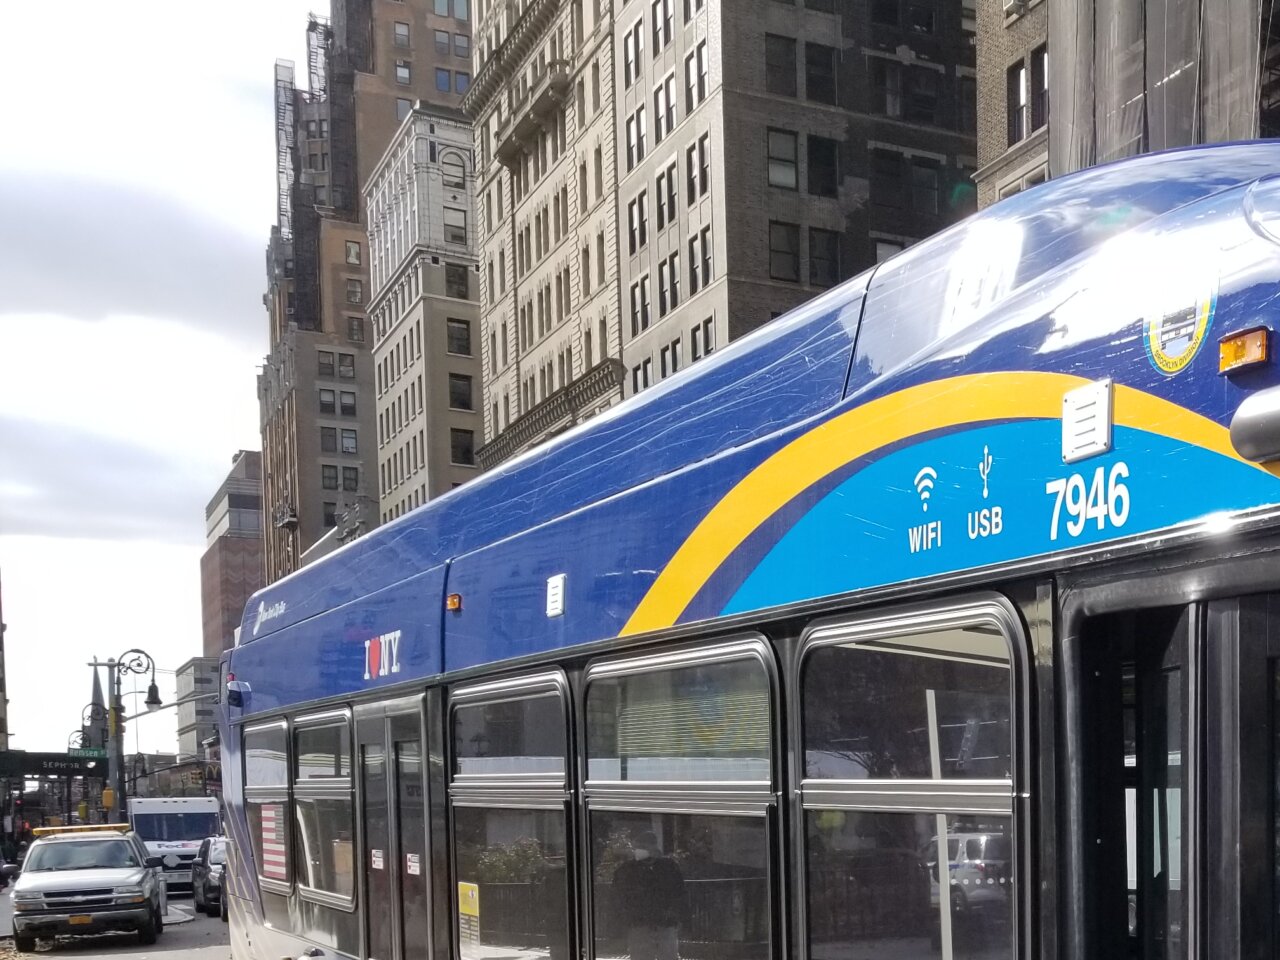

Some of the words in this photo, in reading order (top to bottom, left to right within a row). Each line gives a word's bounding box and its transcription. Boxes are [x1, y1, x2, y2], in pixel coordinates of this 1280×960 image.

[1045, 461, 1131, 541] 7946
[908, 520, 943, 554] WIFI
[967, 505, 1003, 540] USB
